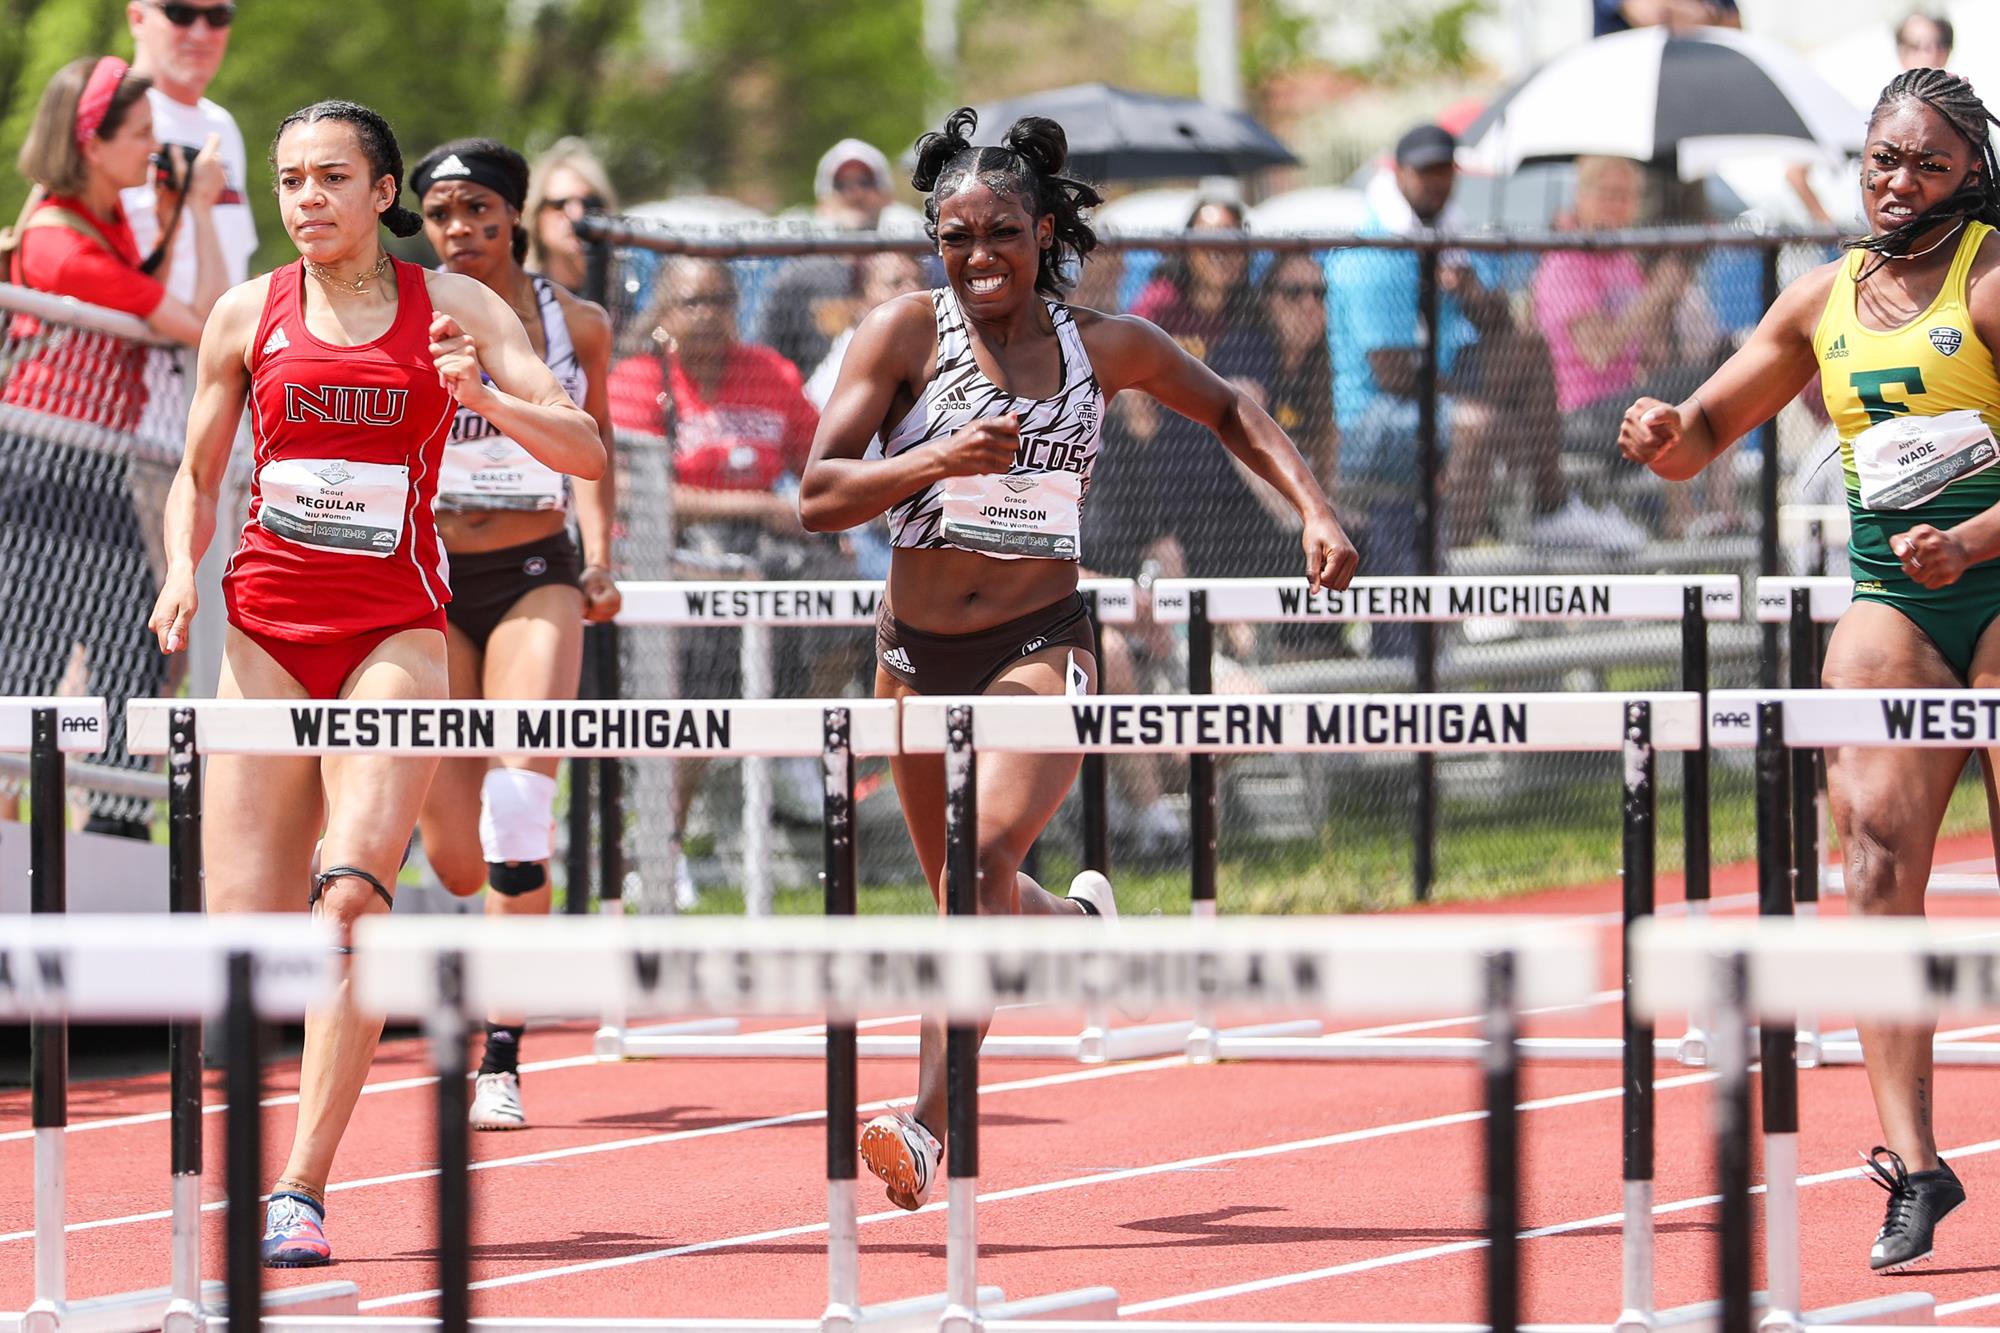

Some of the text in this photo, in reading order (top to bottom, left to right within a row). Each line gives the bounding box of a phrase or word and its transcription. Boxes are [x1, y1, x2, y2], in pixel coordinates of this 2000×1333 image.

[284, 383, 408, 426] NIU
[935, 401, 971, 410] adidas
[1014, 436, 1086, 473] NCOS
[1897, 441, 1936, 466] WADE
[320, 488, 343, 496] Scout
[1004, 496, 1027, 504] Grace
[296, 495, 365, 513] REGULAR
[980, 506, 1046, 521] JOHNSON
[305, 511, 351, 521] NIU Women
[316, 526, 340, 537] MAY
[685, 590, 834, 617] WESTERN
[1278, 585, 1610, 615] WESTERN MICHIGAN
[883, 651, 916, 674] adidas
[291, 707, 731, 749] WESTERN MICHIGAN
[1072, 703, 1527, 744] WESTERN MICHIGAN
